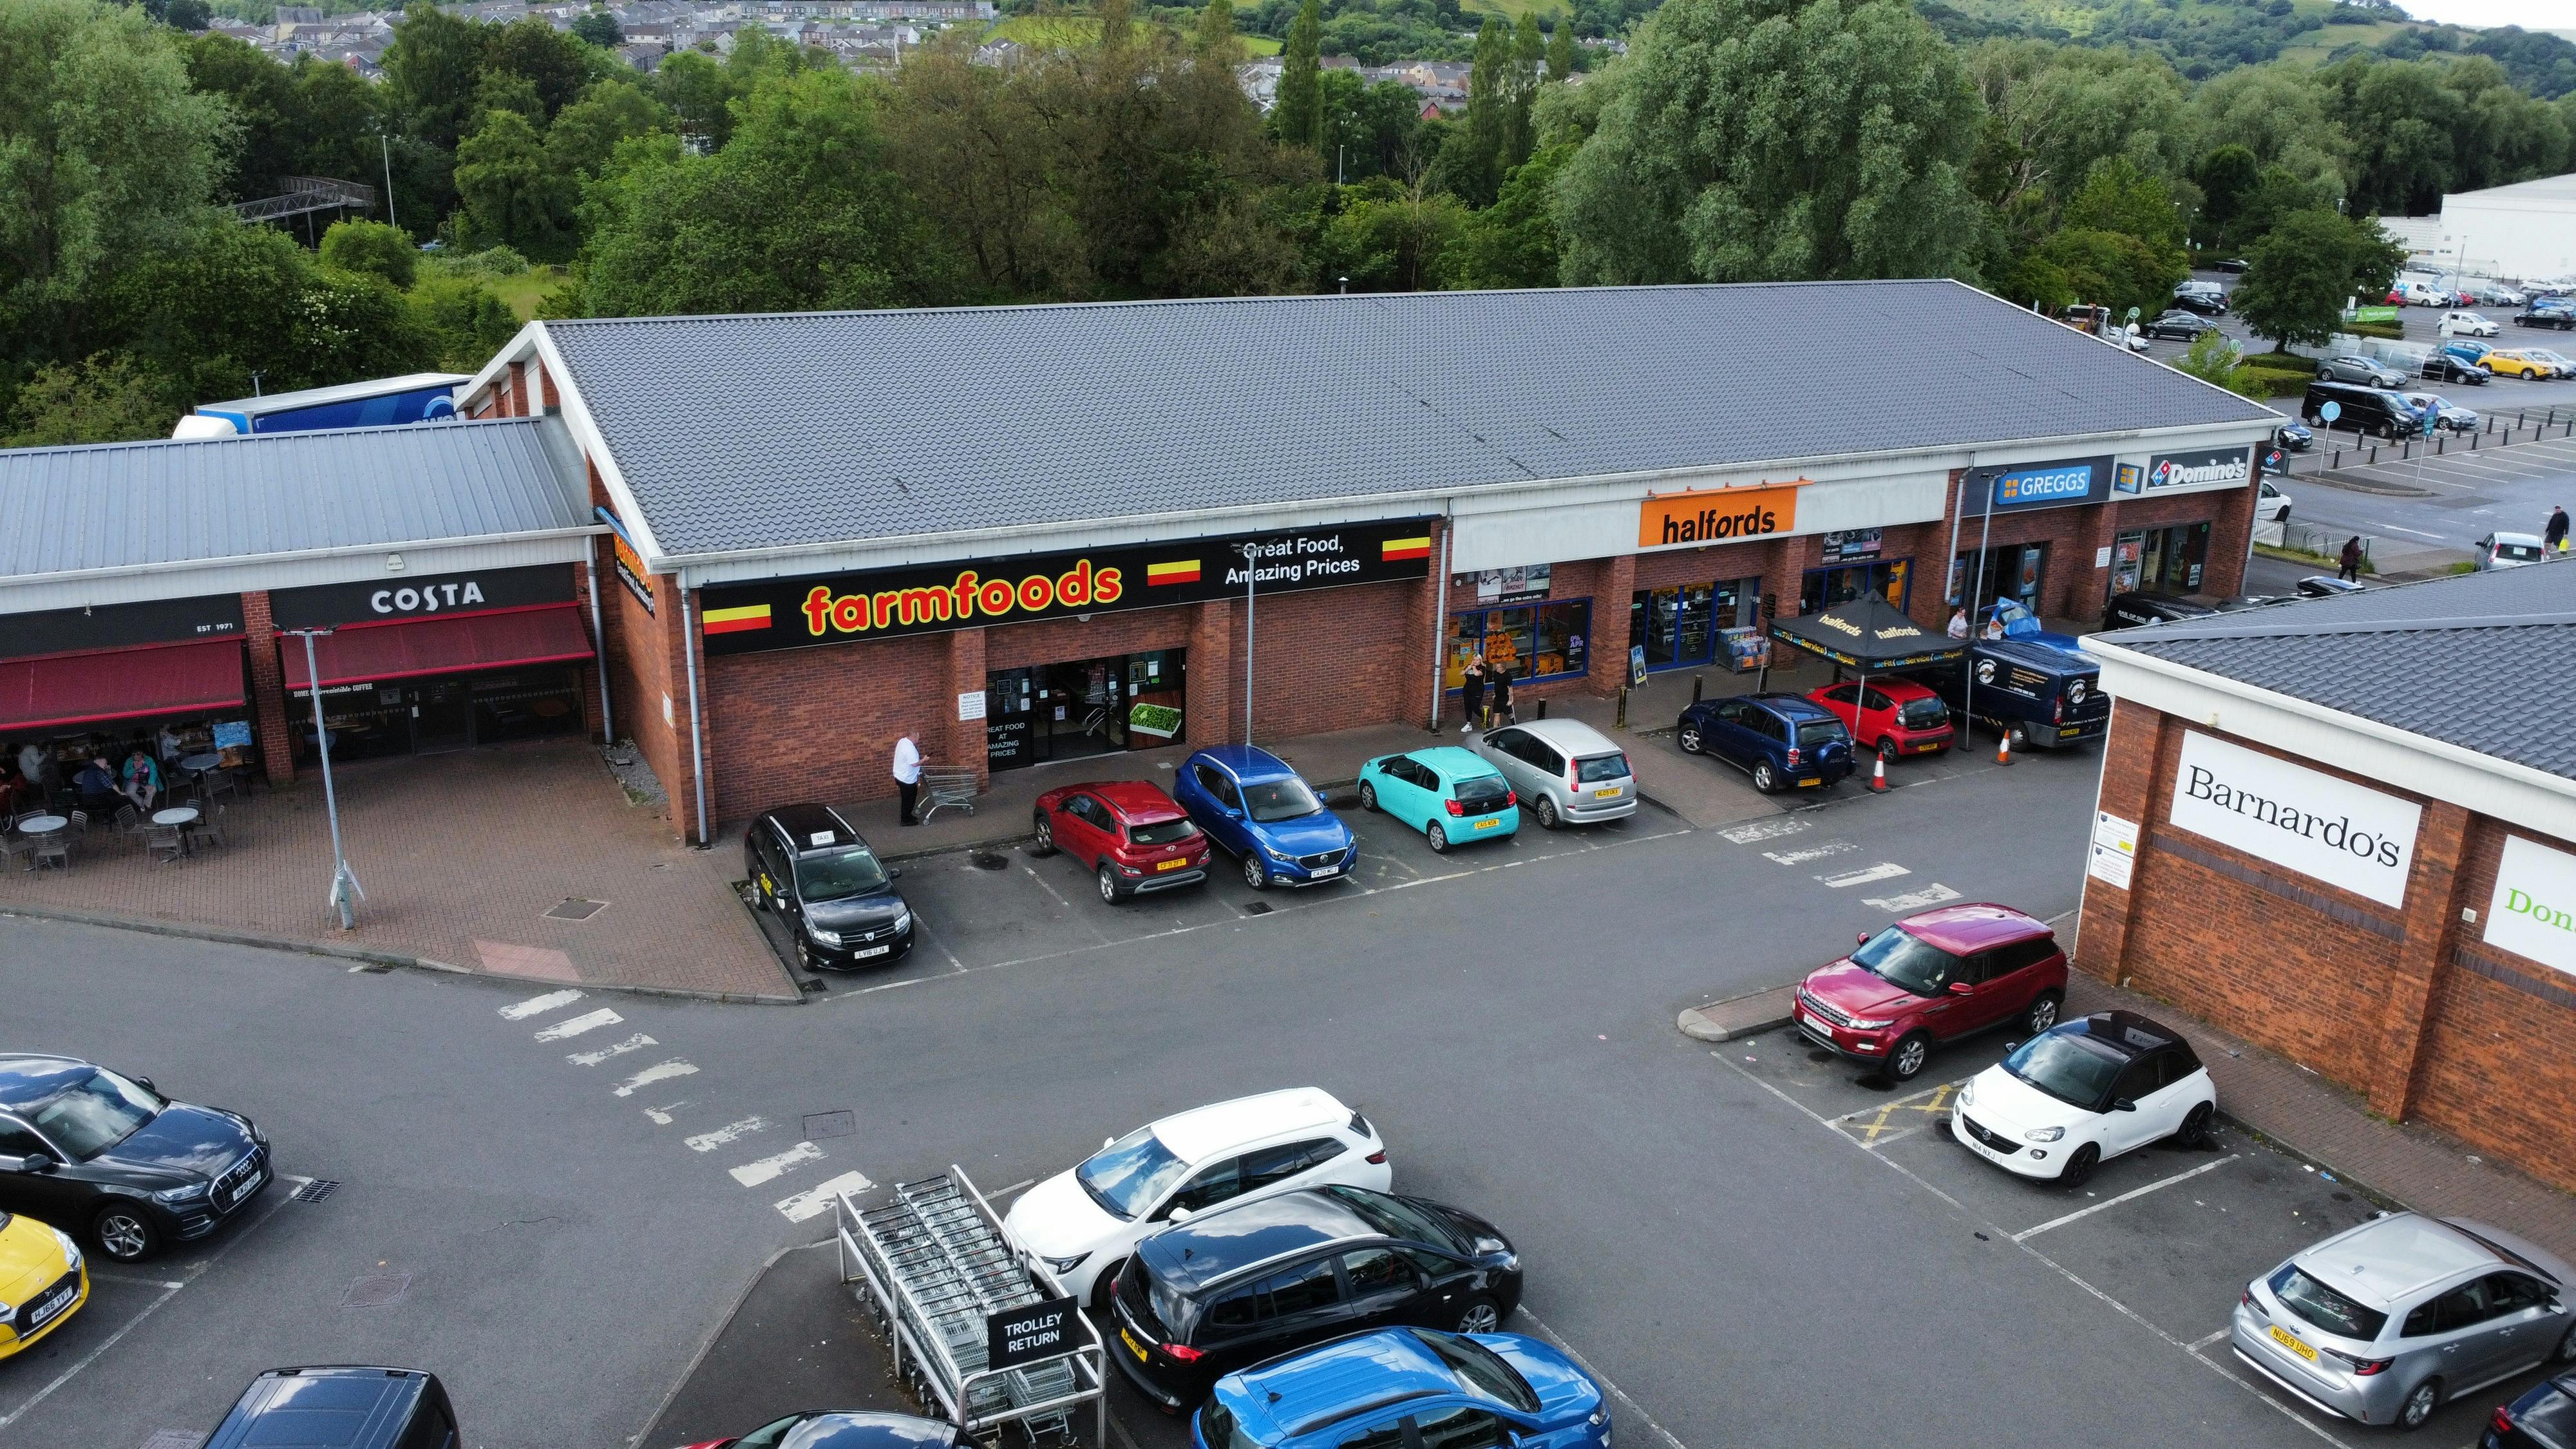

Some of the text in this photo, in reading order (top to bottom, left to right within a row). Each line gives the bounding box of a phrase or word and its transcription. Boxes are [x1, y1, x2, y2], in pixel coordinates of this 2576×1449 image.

[2168, 457, 2246, 485] Domino's
[2021, 471, 2086, 496] GREGGS
[1662, 505, 1776, 545] halfords
[1243, 535, 1343, 559] Great Food,
[1226, 558, 1360, 585] Amazing Prices
[371, 582, 485, 613] COSTA
[802, 559, 1122, 636] farmfoods
[1819, 614, 1862, 636] halfords
[1875, 626, 1921, 639] halfords
[353, 683, 373, 692] COFFEE
[987, 740, 1019, 750] AMAZING
[990, 749, 1016, 757] PRICES
[2185, 765, 2400, 867] Barnardo's
[2505, 888, 2576, 933] Don
[1983, 1149, 1995, 1160] NXJ
[57, 1287, 71, 1306] YVT
[1005, 1312, 1063, 1336] TROLLEY
[1009, 1330, 1059, 1352] RETURN
[2273, 1329, 2313, 1359] NU69 UHO
